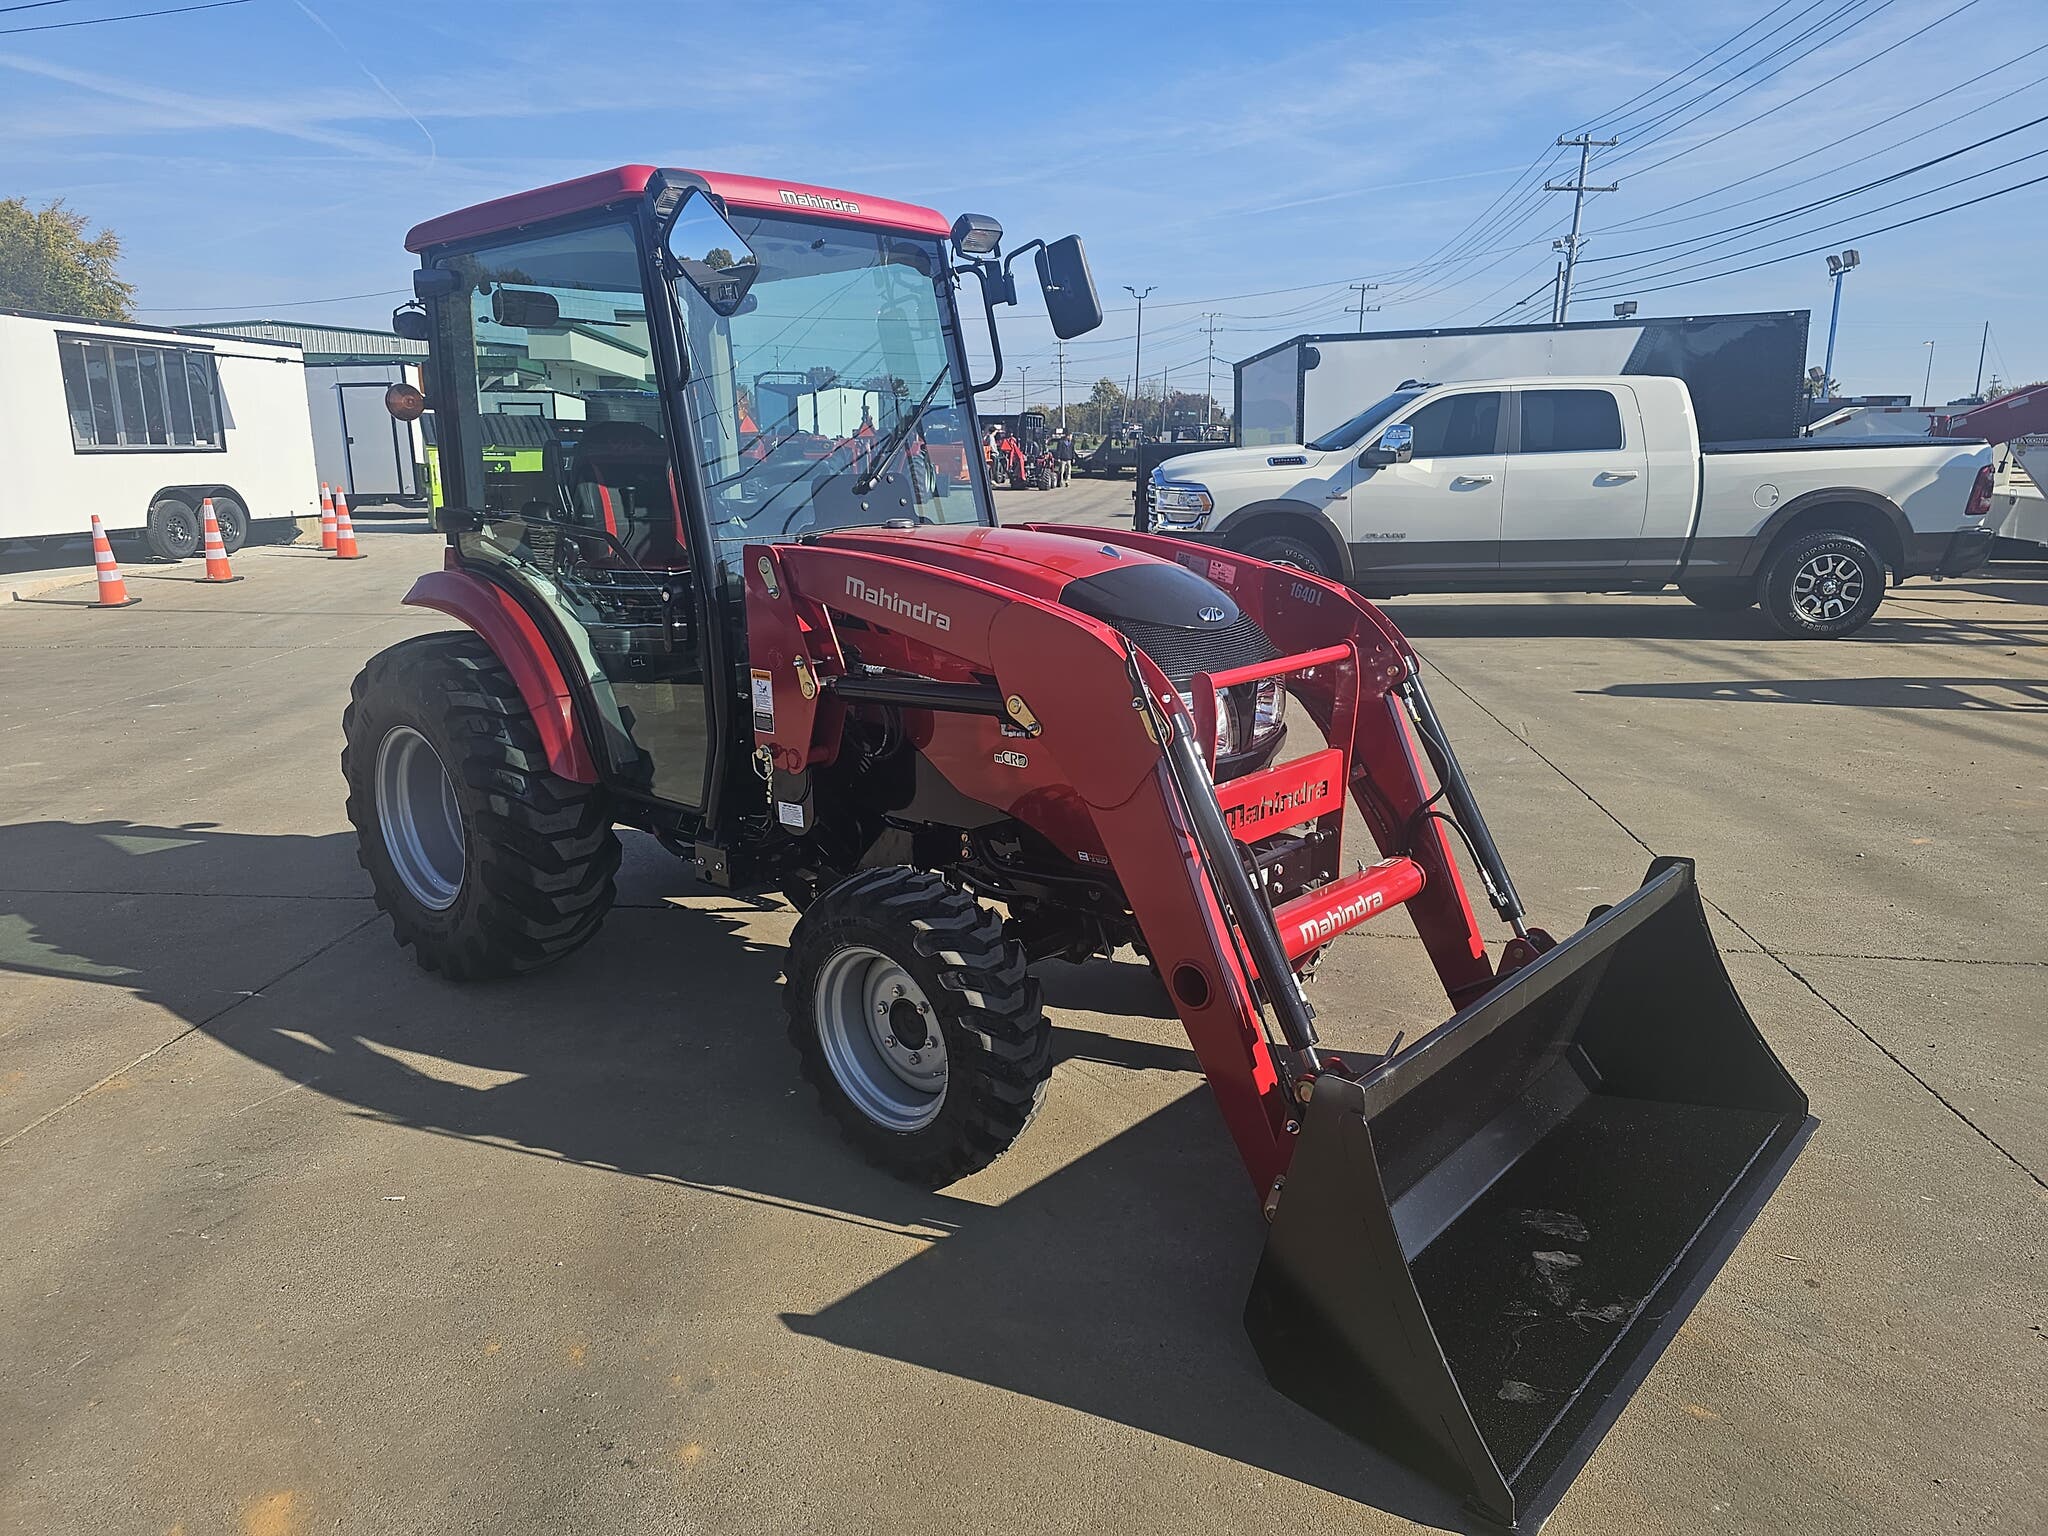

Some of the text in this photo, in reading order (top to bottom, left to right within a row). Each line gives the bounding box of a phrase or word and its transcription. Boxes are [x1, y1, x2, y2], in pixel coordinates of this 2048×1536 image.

[778, 190, 860, 214] Mahindra
[845, 575, 951, 631] Mahindra
[1224, 780, 1328, 830] Mahindra
[1299, 891, 1384, 945] Mahindra
